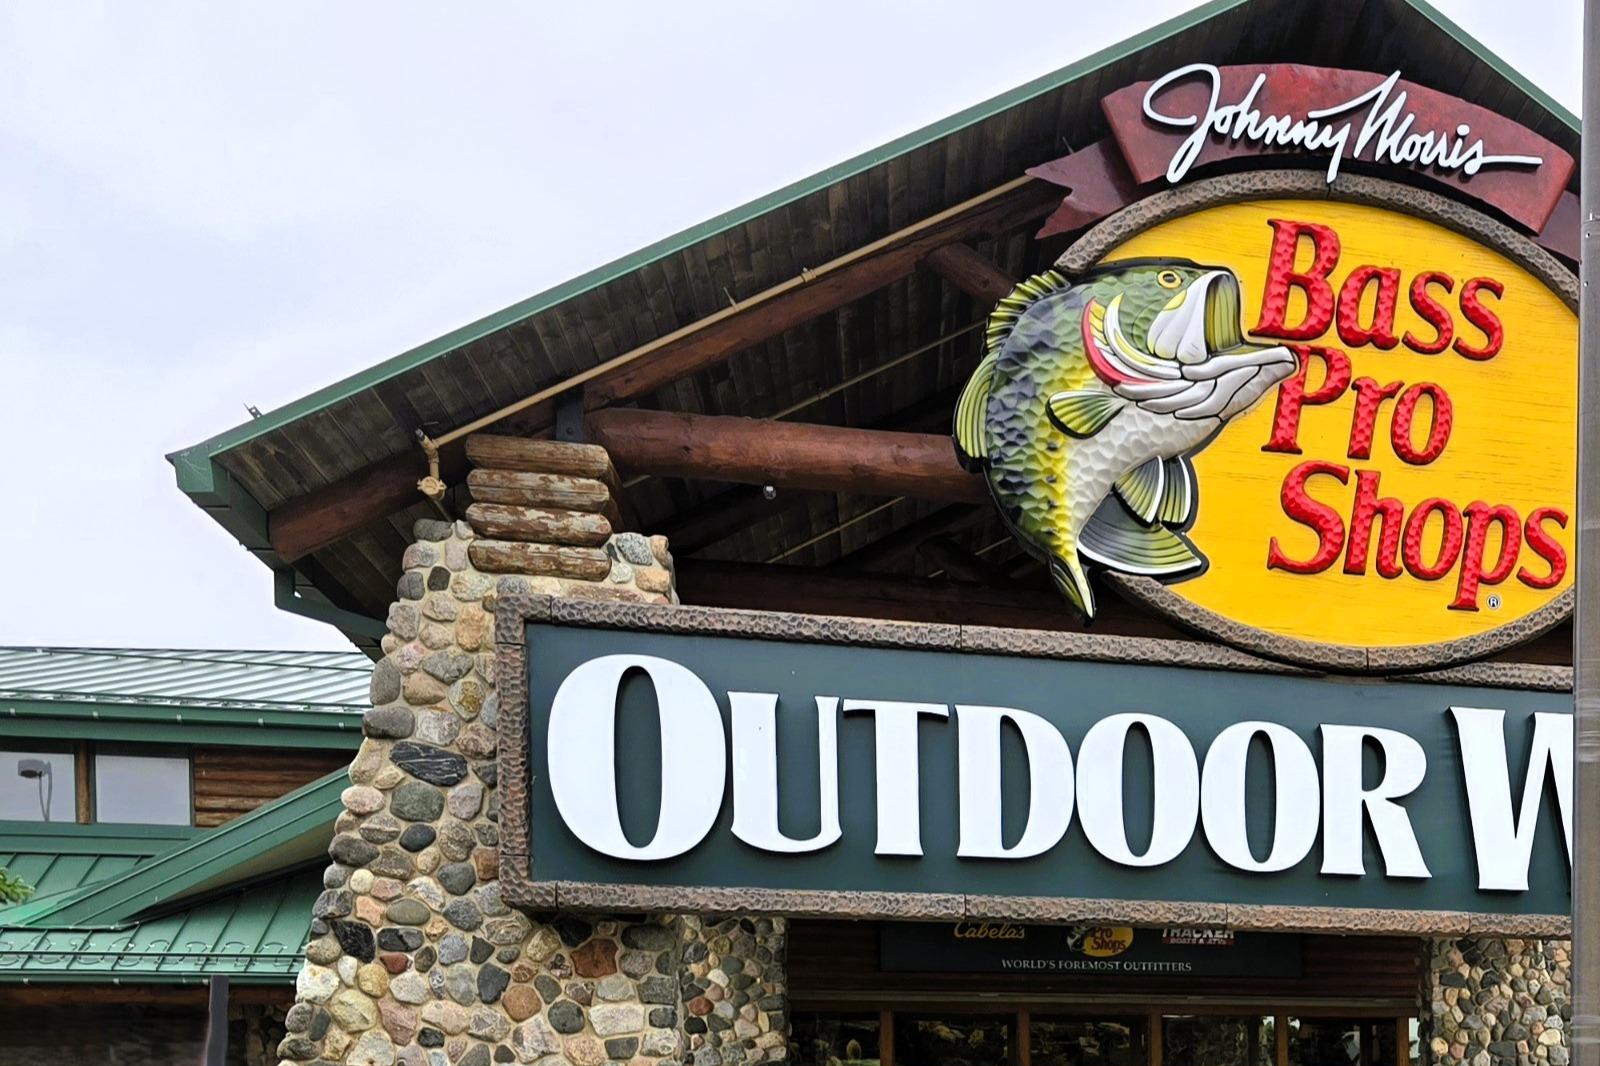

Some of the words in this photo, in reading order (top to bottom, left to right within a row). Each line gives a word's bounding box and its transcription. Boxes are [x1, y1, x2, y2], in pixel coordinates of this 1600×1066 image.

[1143, 63, 1351, 183] Johnny
[1308, 70, 1542, 175] Morris
[1248, 219, 1504, 361] Bass
[1261, 343, 1453, 465] Pro
[1267, 460, 1568, 611] Shops
[547, 654, 1432, 878] OUTDOOR
[1002, 959, 1056, 969] WORLD'S
[1058, 960, 1121, 971] FOREMOST
[1123, 961, 1192, 972] OUTFITTERS
[1091, 938, 1126, 953] Shops
